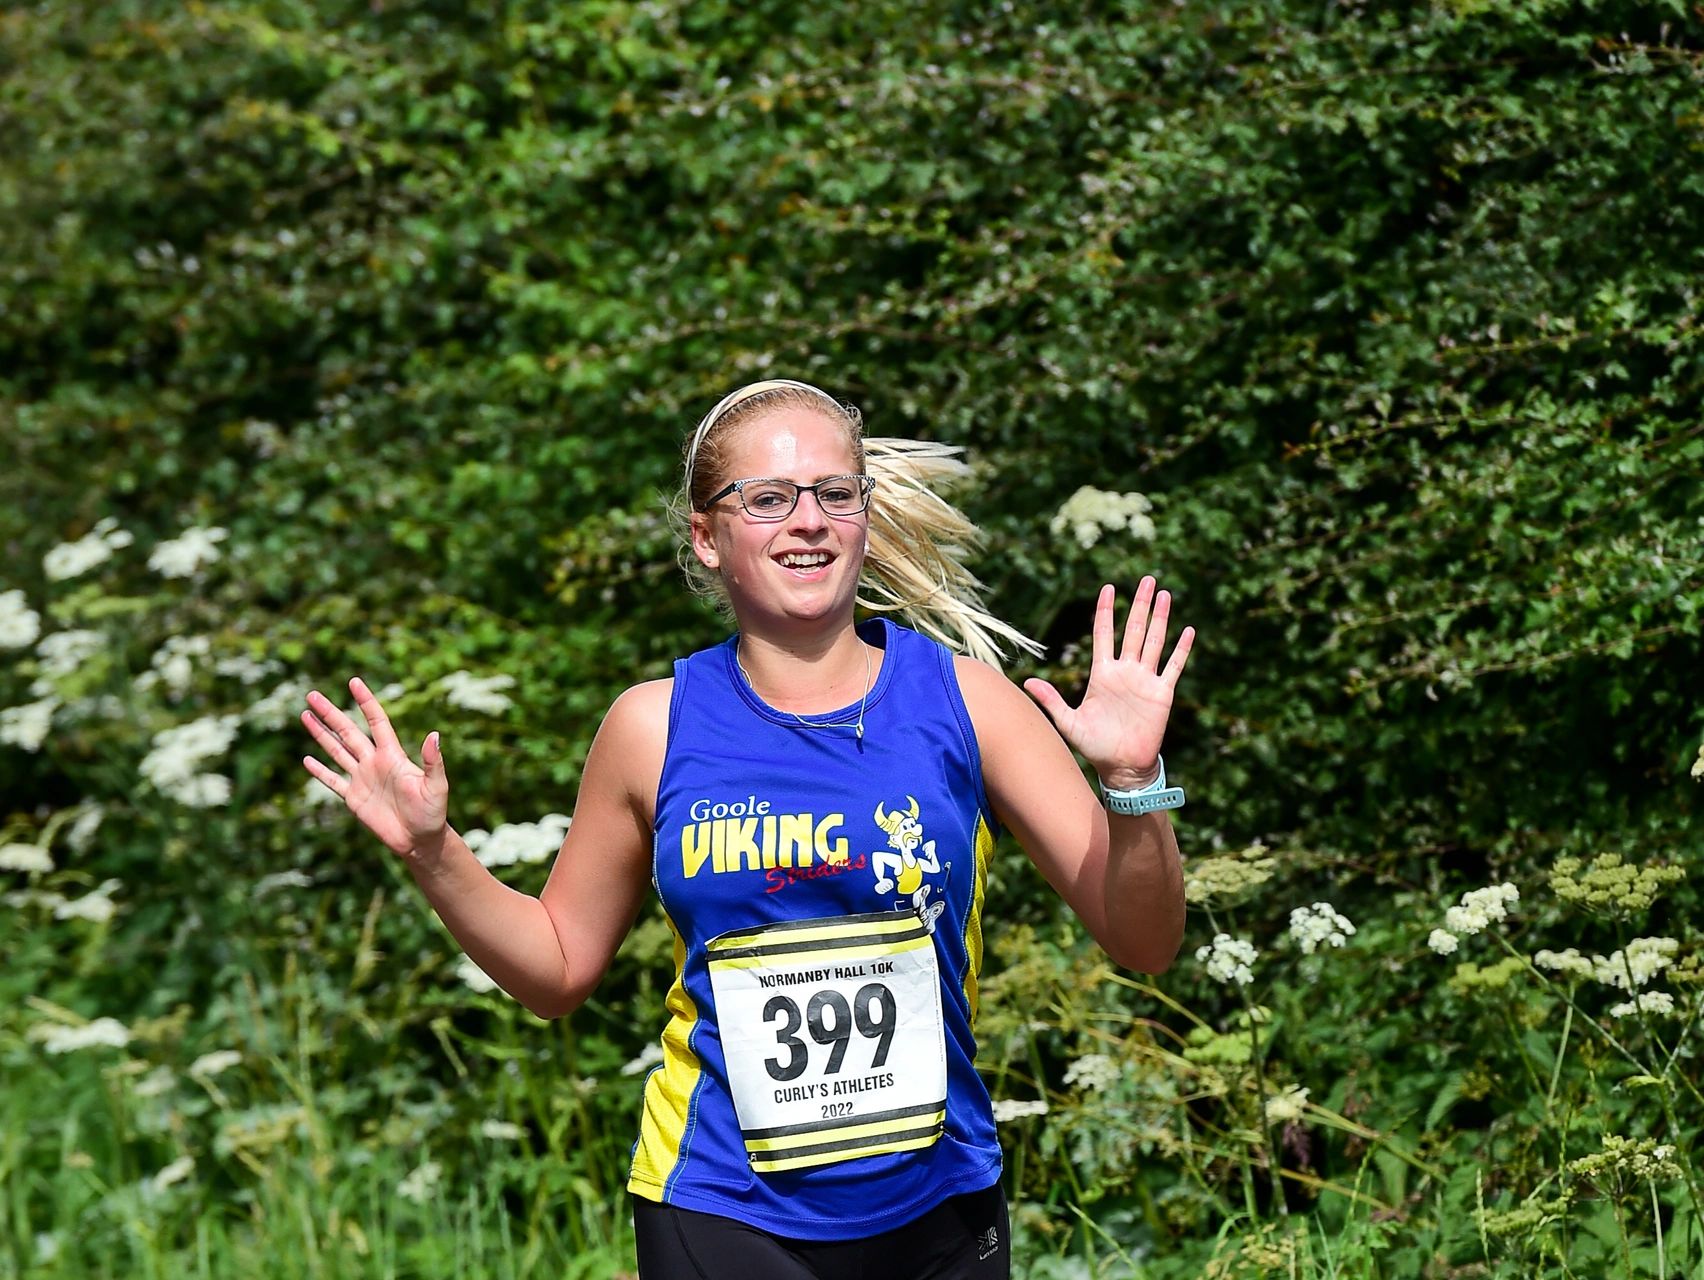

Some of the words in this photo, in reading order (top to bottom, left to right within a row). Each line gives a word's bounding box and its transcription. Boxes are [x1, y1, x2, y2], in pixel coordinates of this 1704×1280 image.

[690, 795, 771, 820] Goole
[680, 812, 848, 879] VIKING
[759, 968, 831, 988] NORMANBY
[835, 965, 867, 981] HALL
[870, 961, 894, 976] 10K
[763, 982, 897, 1082] 399
[774, 1083, 829, 1104] CURLY'S
[833, 1073, 895, 1097] ATHLETES
[821, 1101, 854, 1118] 2022
